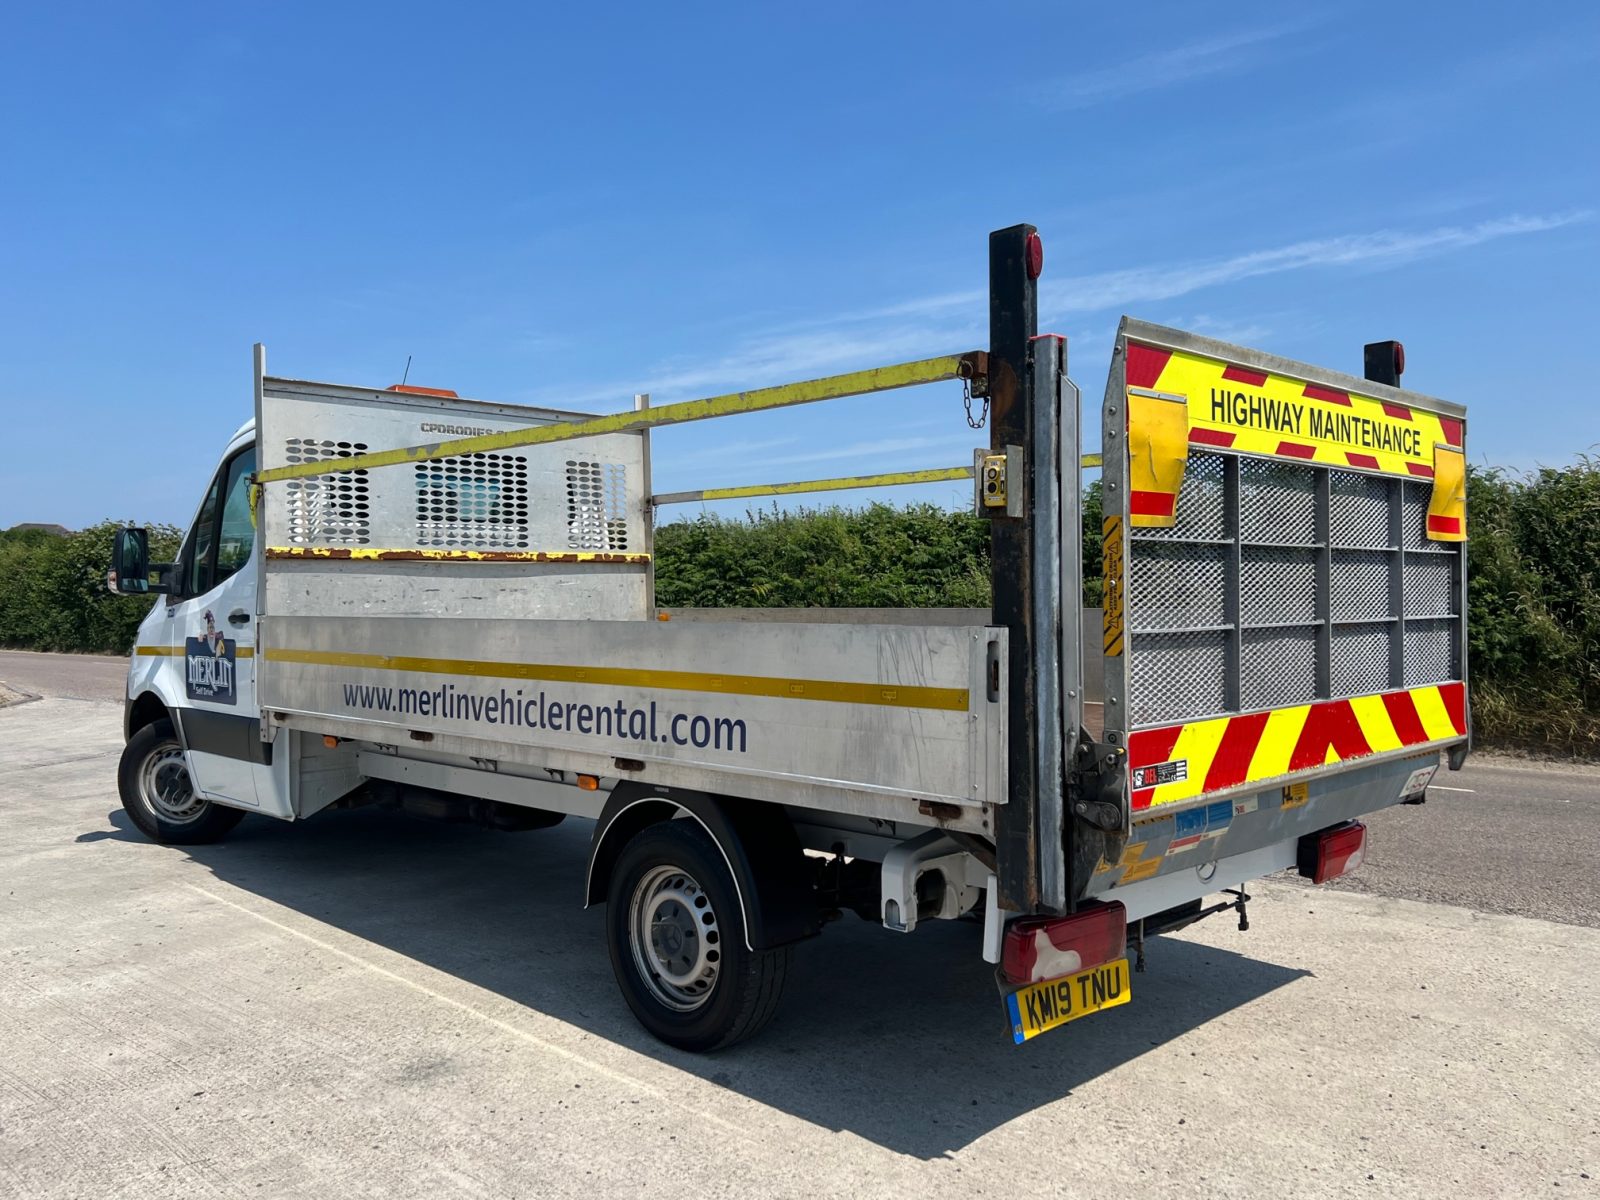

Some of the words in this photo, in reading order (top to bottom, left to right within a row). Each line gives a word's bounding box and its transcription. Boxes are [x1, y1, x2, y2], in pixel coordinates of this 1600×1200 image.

[1211, 388, 1304, 434] HIGHWAY
[1309, 407, 1421, 456] MAINTENANCE
[188, 655, 232, 696] MERLIN
[343, 684, 746, 752] www.merlinvehiclerental.com
[1025, 981, 1071, 1032] KM19
[1077, 966, 1121, 1008] TNU
